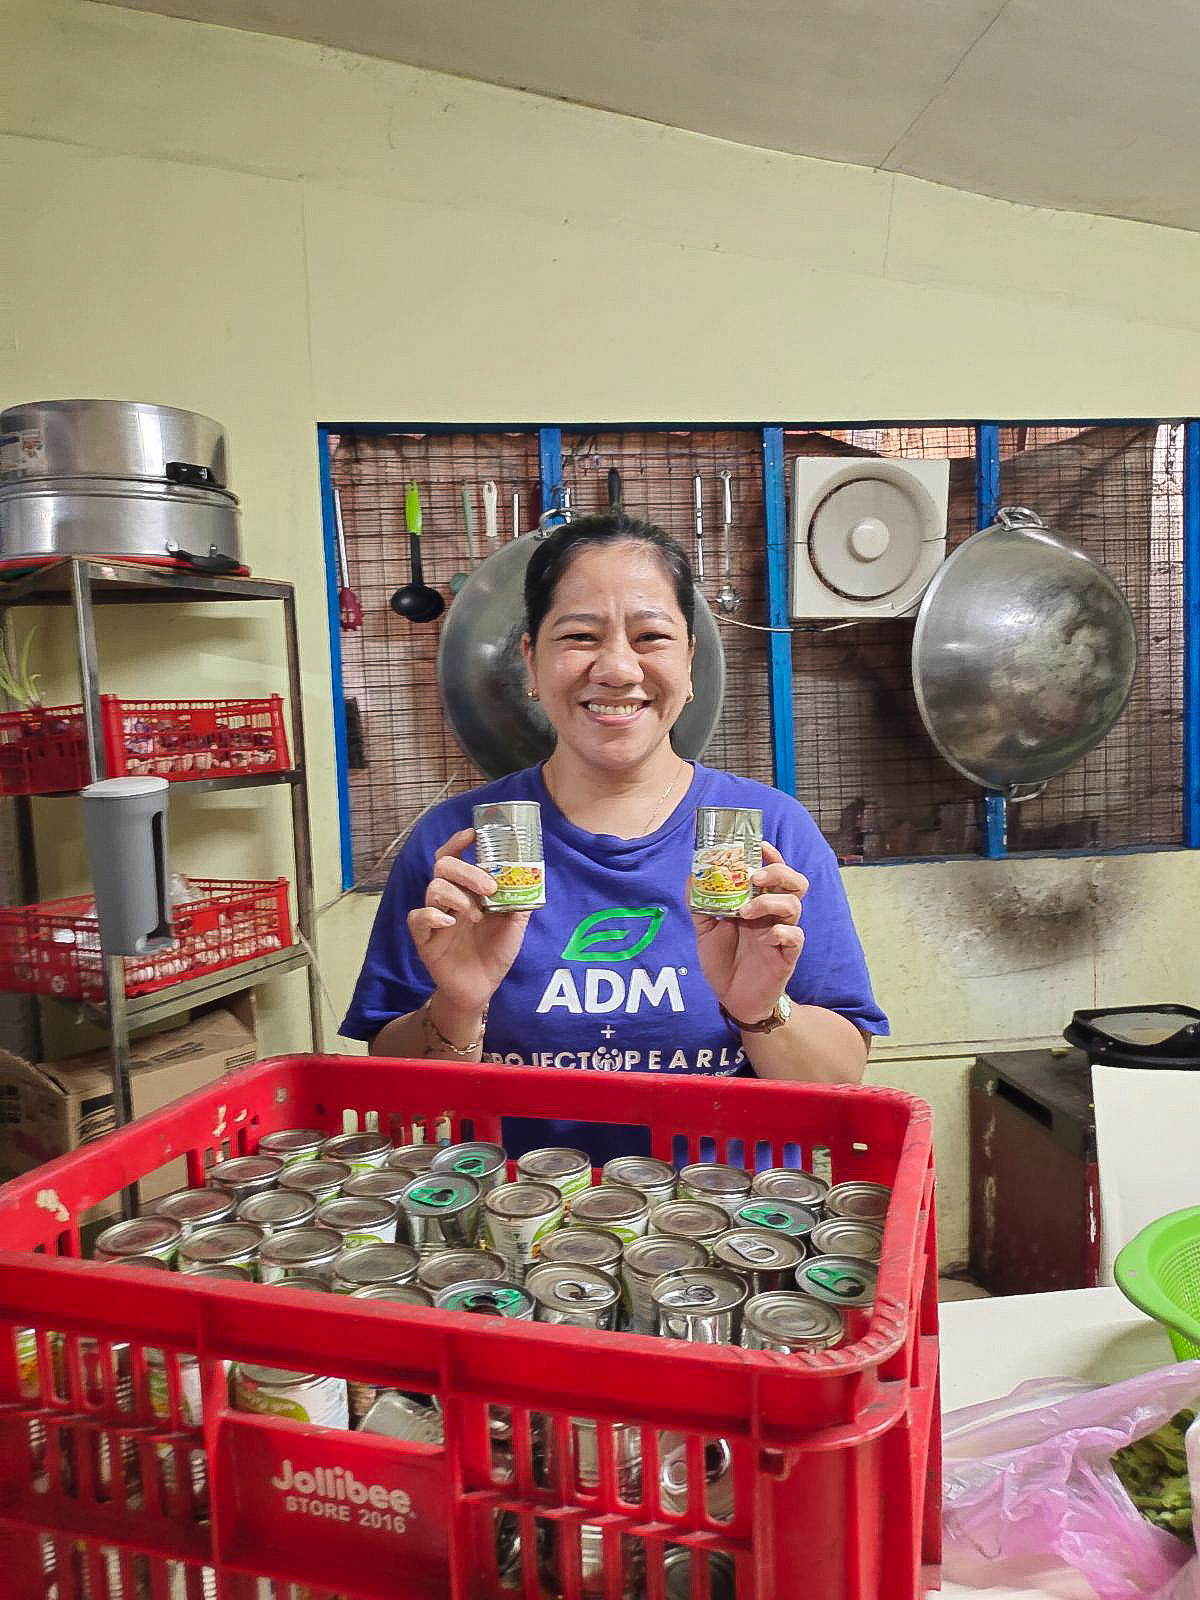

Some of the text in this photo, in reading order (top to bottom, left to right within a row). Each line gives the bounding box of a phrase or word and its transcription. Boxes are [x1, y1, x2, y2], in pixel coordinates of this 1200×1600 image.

[536, 967, 685, 1013] ADM
[624, 1046, 745, 1071] PEARLS
[272, 1459, 411, 1514] Jollibee
[285, 1495, 406, 1534] STORE 2016
